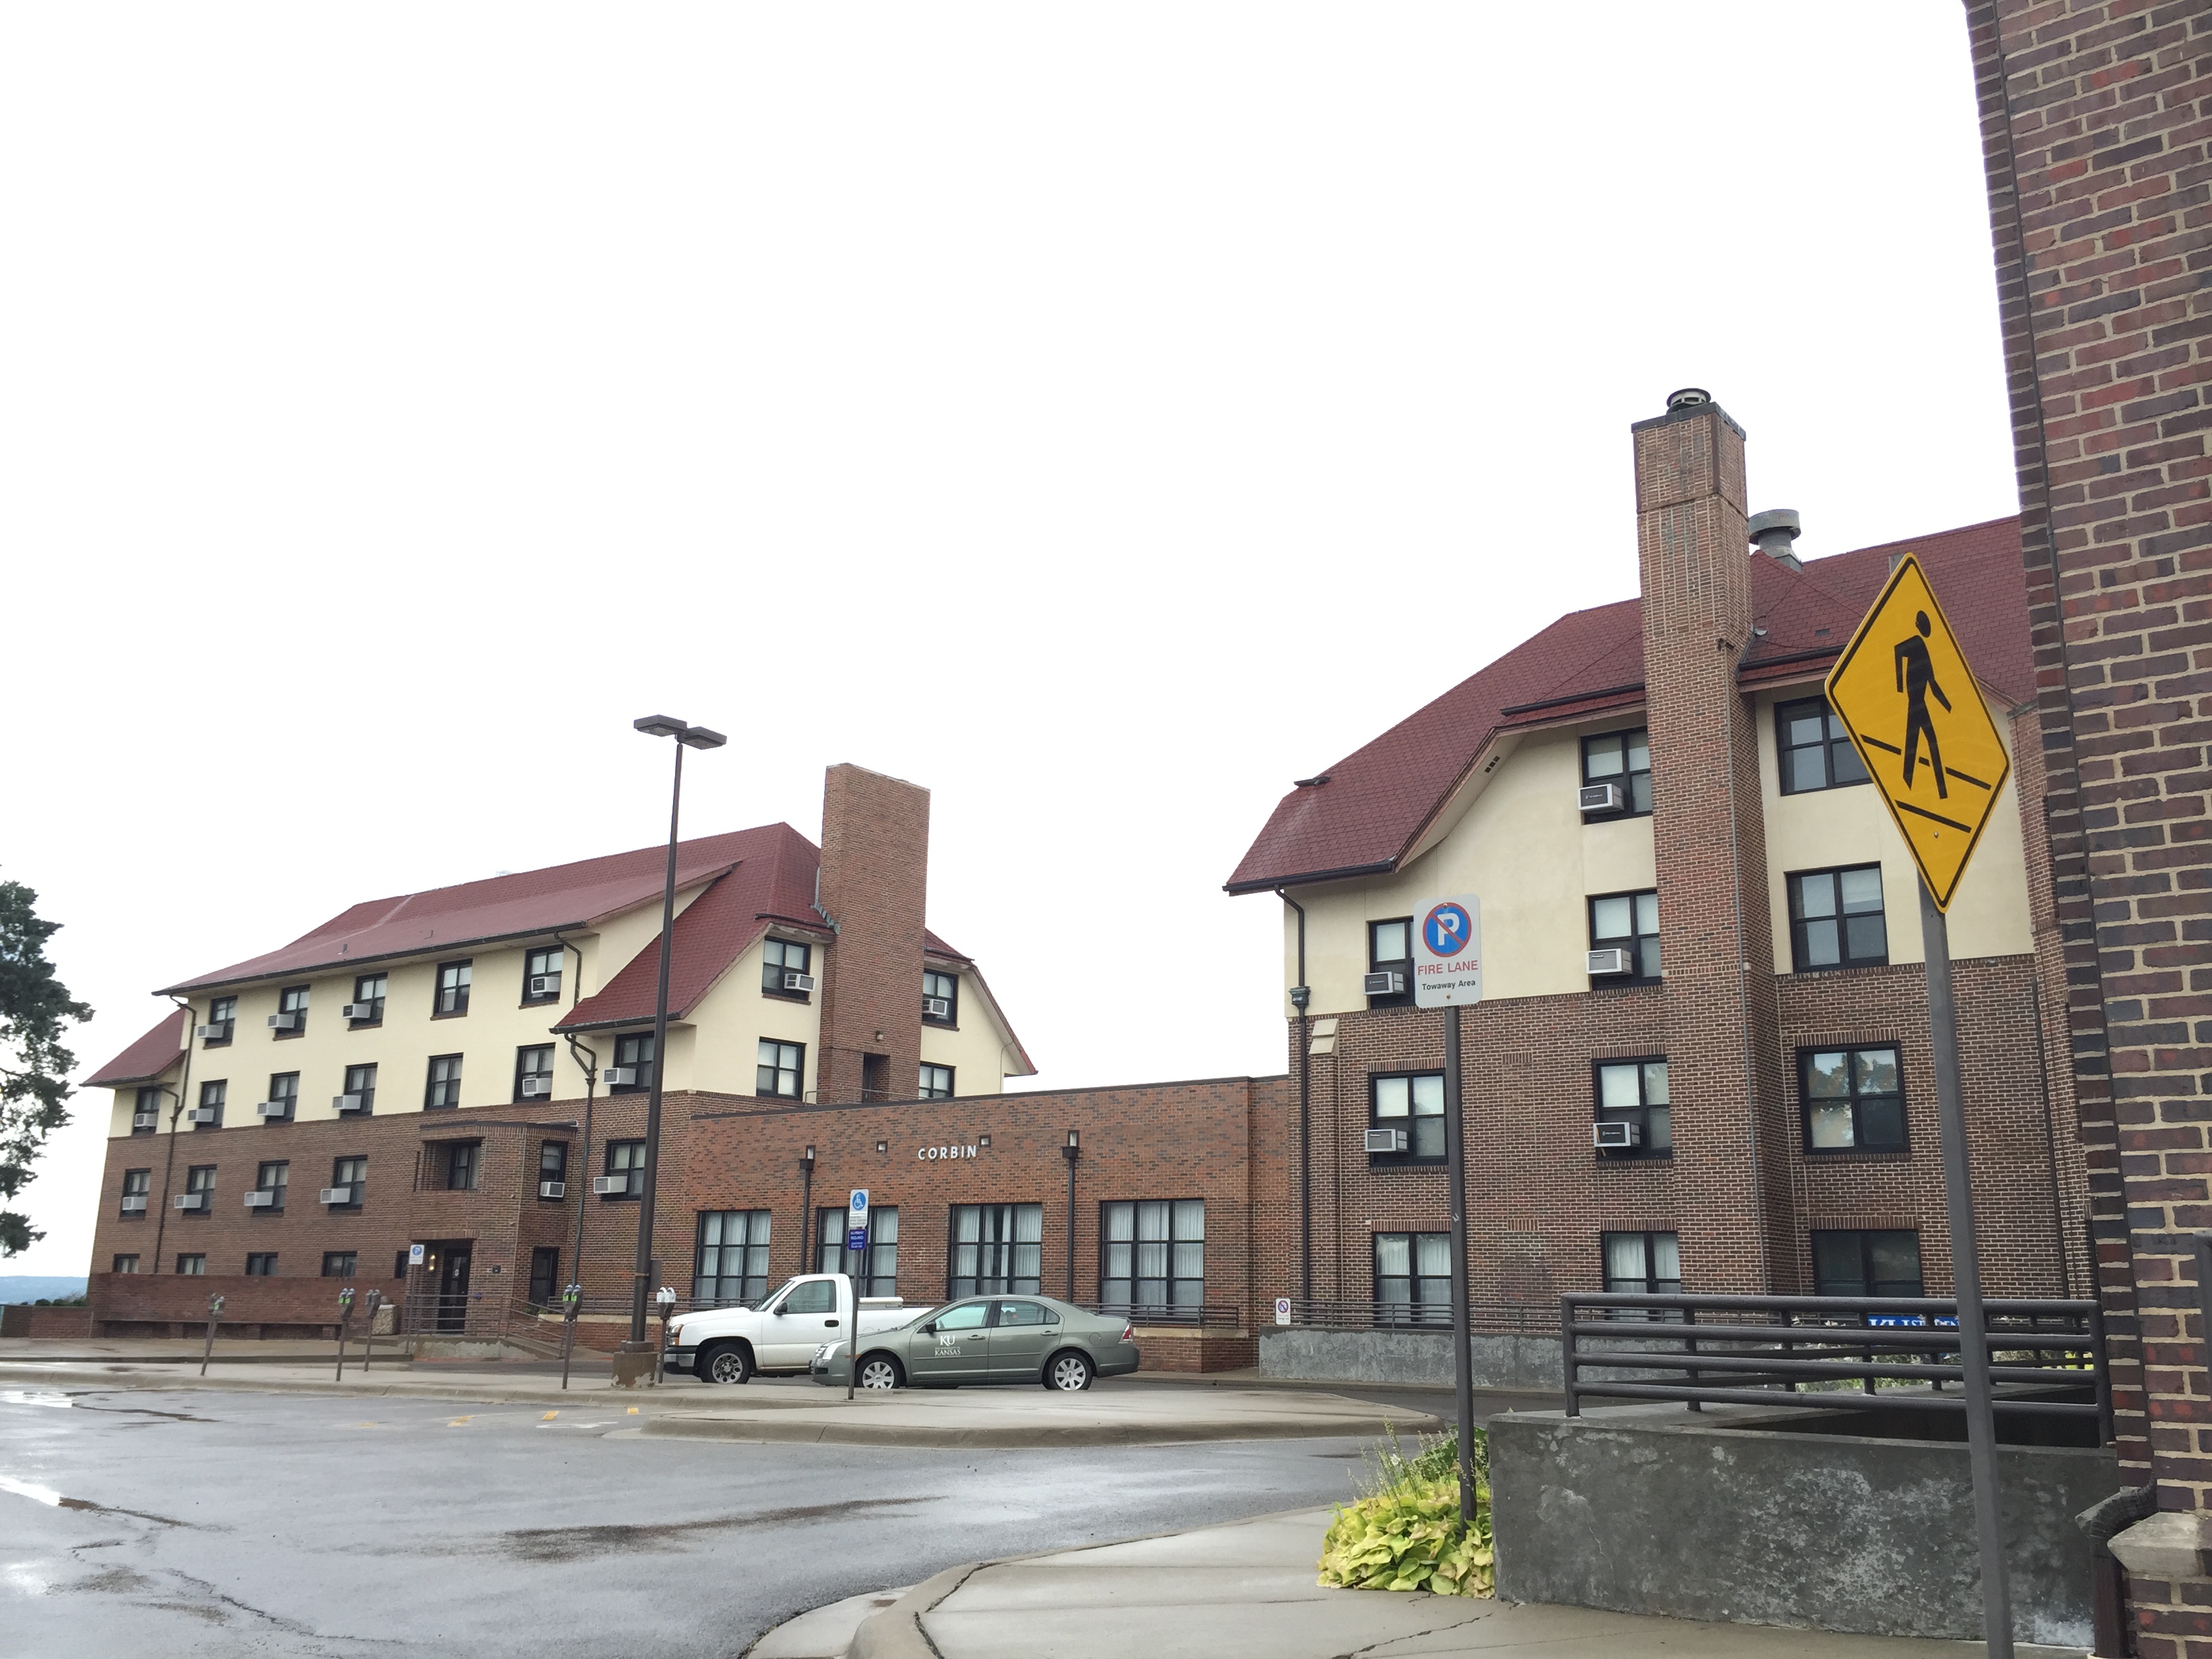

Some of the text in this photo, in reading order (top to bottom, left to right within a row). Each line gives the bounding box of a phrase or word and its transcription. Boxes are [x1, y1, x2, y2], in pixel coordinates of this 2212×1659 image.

[1418, 960, 1478, 975] FIRE LANE
[1422, 982, 1456, 990] Towaway
[918, 1145, 977, 1160] CORBIN
[940, 1335, 956, 1346] KU
